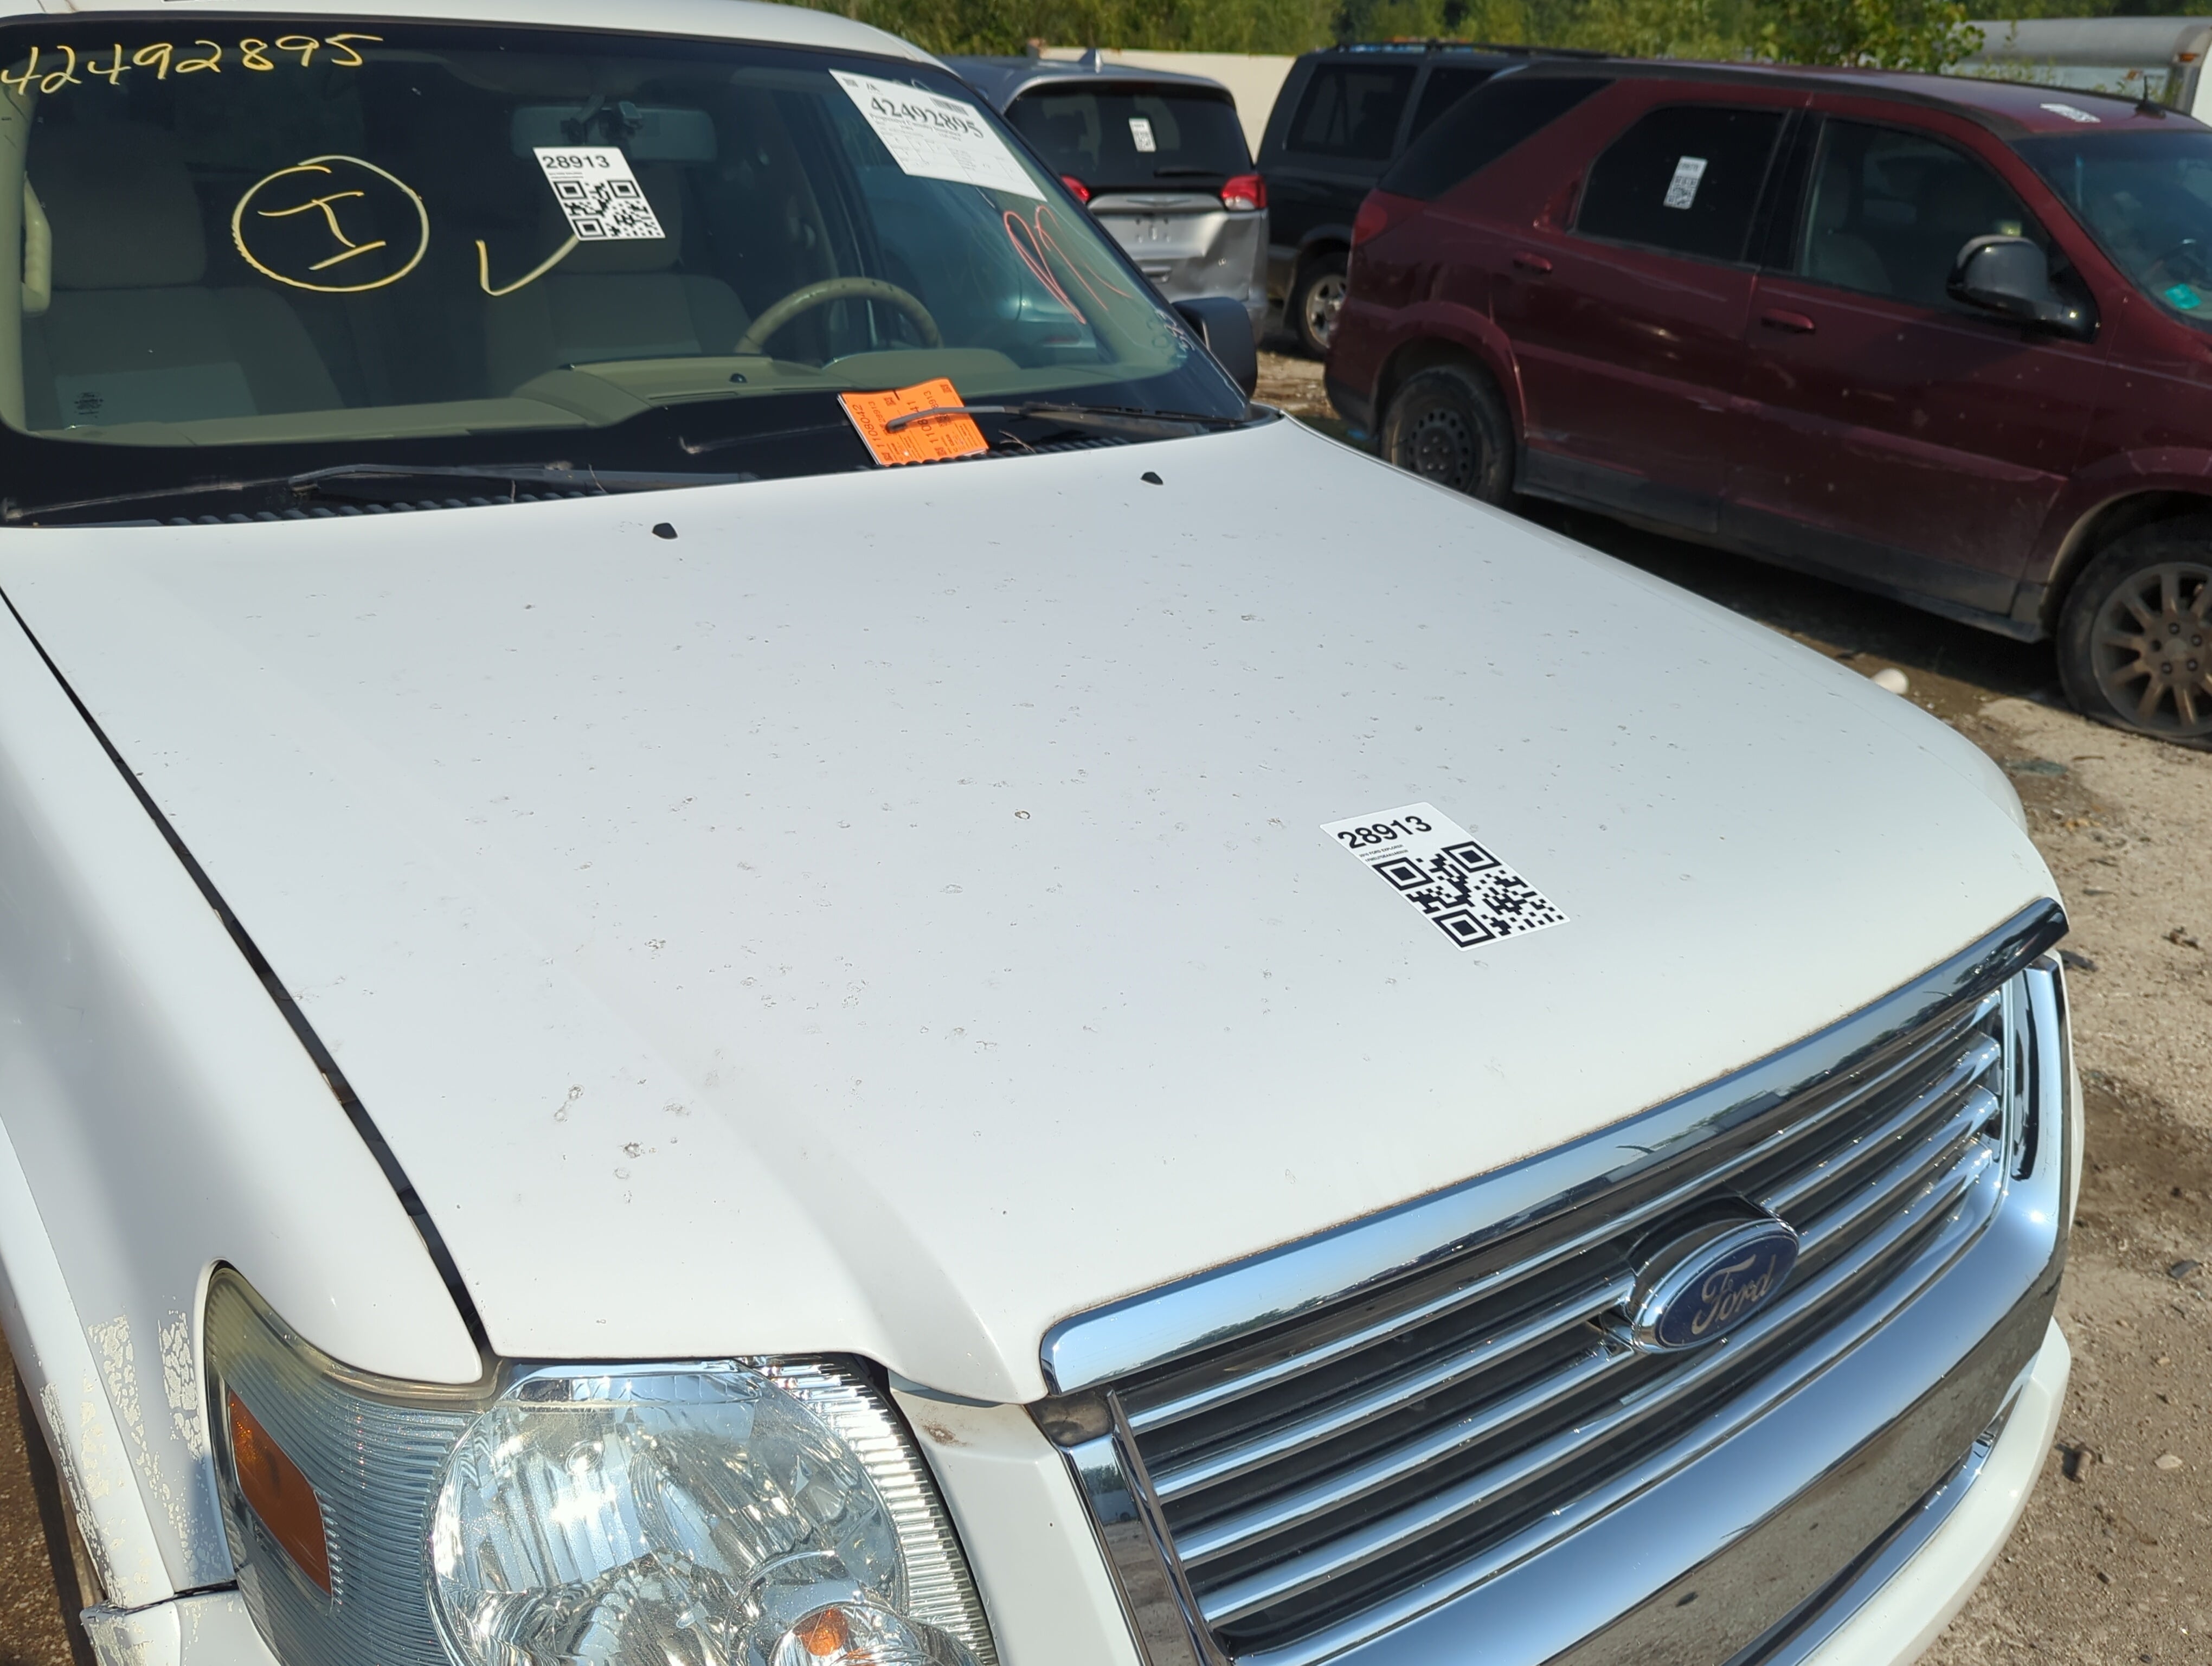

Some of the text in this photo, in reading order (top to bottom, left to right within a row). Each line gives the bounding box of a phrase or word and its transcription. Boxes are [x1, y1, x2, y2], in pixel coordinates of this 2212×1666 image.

[1, 34, 384, 95] 42492895
[870, 97, 984, 139] 42492895
[542, 155, 610, 169] 28913
[852, 404, 885, 448] 1108042
[906, 401, 939, 444] 110841
[1338, 816, 1432, 849] 28913
[1691, 1253, 1777, 1335] Ford
